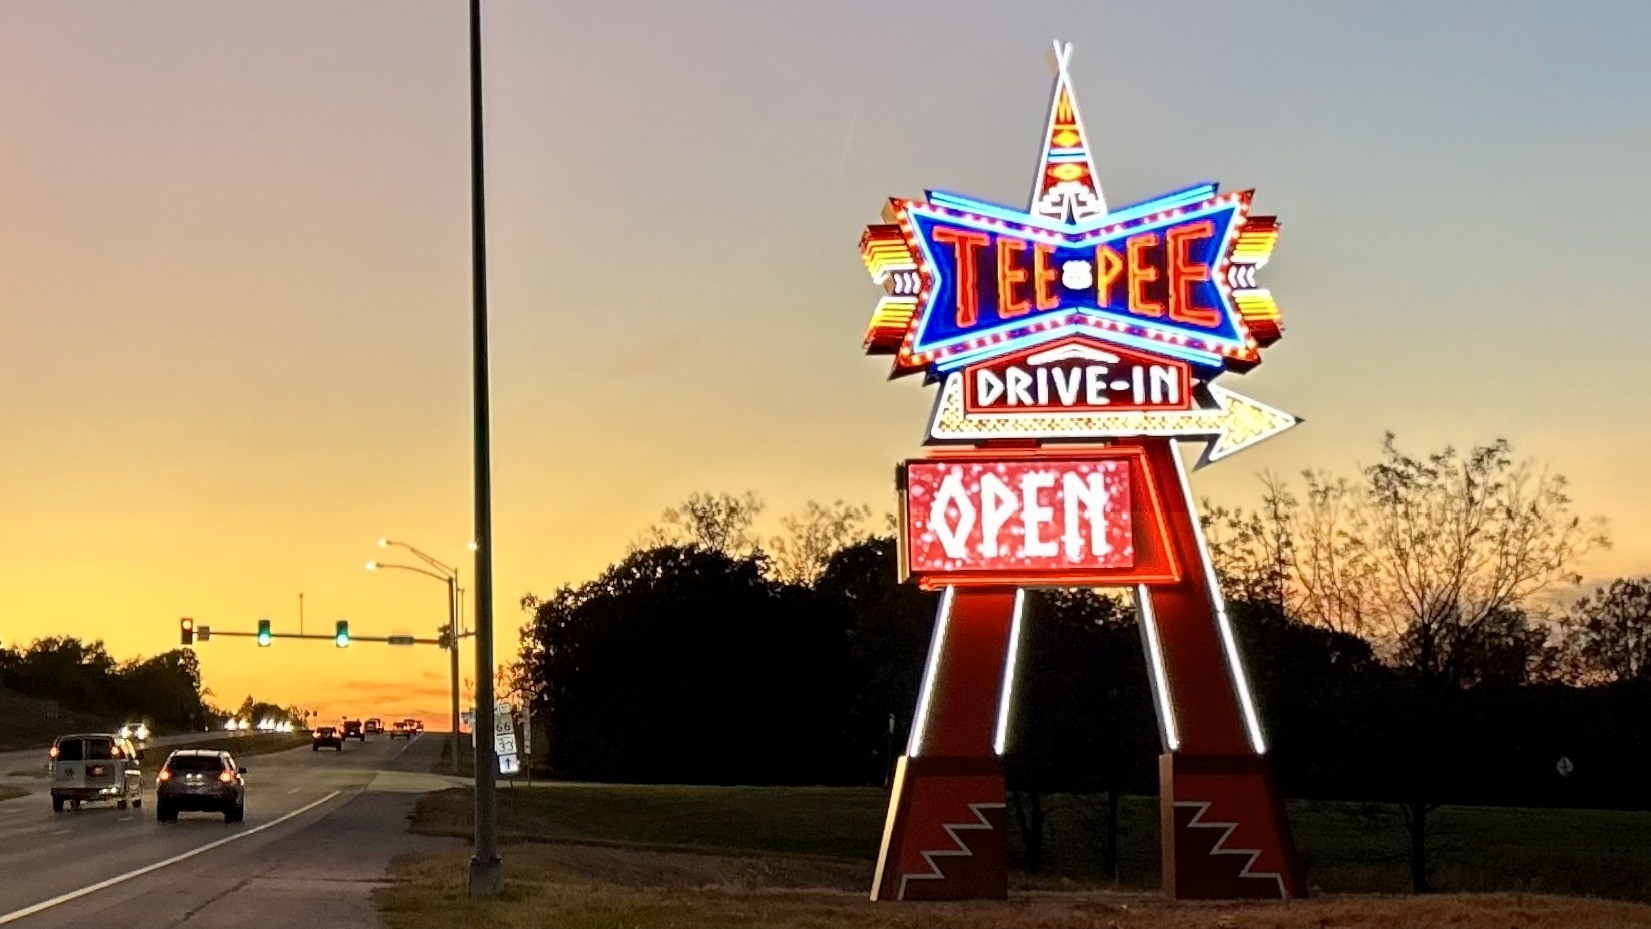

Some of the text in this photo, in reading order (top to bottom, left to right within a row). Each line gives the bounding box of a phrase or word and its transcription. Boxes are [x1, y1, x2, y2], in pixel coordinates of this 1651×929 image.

[931, 220, 1221, 328] TEE PEE
[977, 364, 1179, 407] DRIVE-IN
[929, 472, 1110, 561] OPEN
[496, 721, 511, 732] 66
